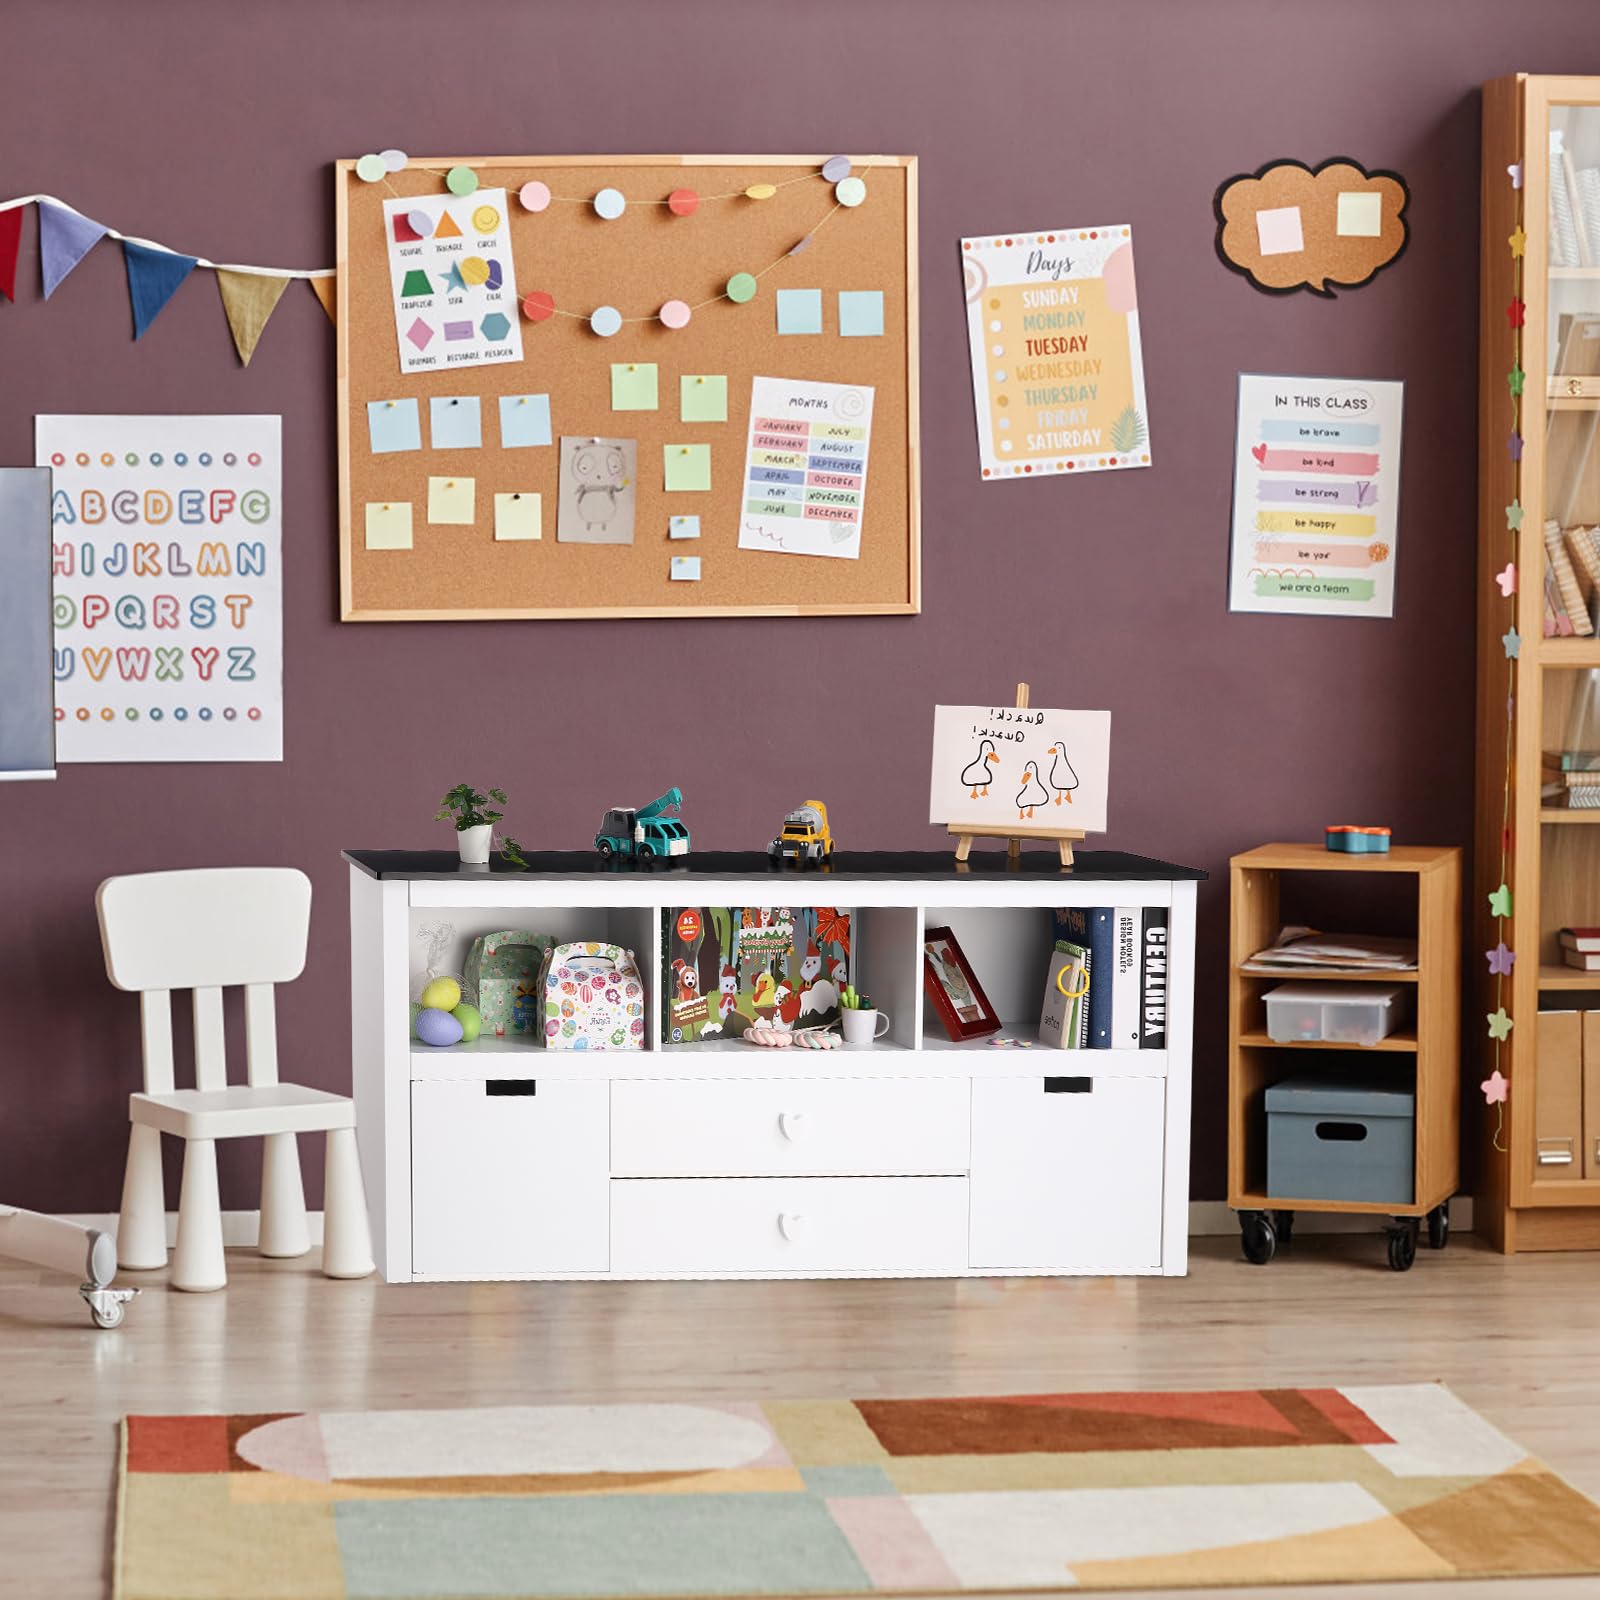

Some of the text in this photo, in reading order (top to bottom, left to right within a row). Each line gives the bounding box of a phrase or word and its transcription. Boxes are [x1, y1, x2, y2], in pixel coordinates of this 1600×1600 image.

[1026, 249, 1075, 281] Days
[1022, 286, 1079, 309] SUNDAY
[1023, 310, 1086, 332] MONDAY
[1025, 335, 1089, 357] TUESDAY
[1016, 359, 1102, 382] WEDNESDAY
[1024, 384, 1098, 406] THURSDAY
[788, 397, 828, 409] MONTHS
[1275, 395, 1368, 410] IN THIS CLASS
[1037, 408, 1089, 428] FRIDAY
[763, 421, 802, 432] JANUARY
[828, 428, 850, 437] JULY
[1299, 428, 1340, 437] be brave
[758, 436, 803, 448] FEBRUARY
[1027, 429, 1102, 452] SATURDAY
[820, 443, 854, 453] AUGUST
[764, 454, 795, 465] MARCH
[811, 459, 862, 472] SEPTEMBER
[1302, 458, 1334, 467] be kind
[764, 471, 790, 480] APRIL
[814, 475, 854, 487] OCTOBER
[767, 488, 786, 497] MAY
[808, 492, 856, 503] NOVEMBER
[1295, 488, 1339, 501] be strong
[764, 503, 785, 513] JUNE
[808, 508, 854, 519] DECEMBER
[1295, 519, 1336, 530] be happy
[1295, 585, 1312, 593] are
[1323, 584, 1349, 594] team
